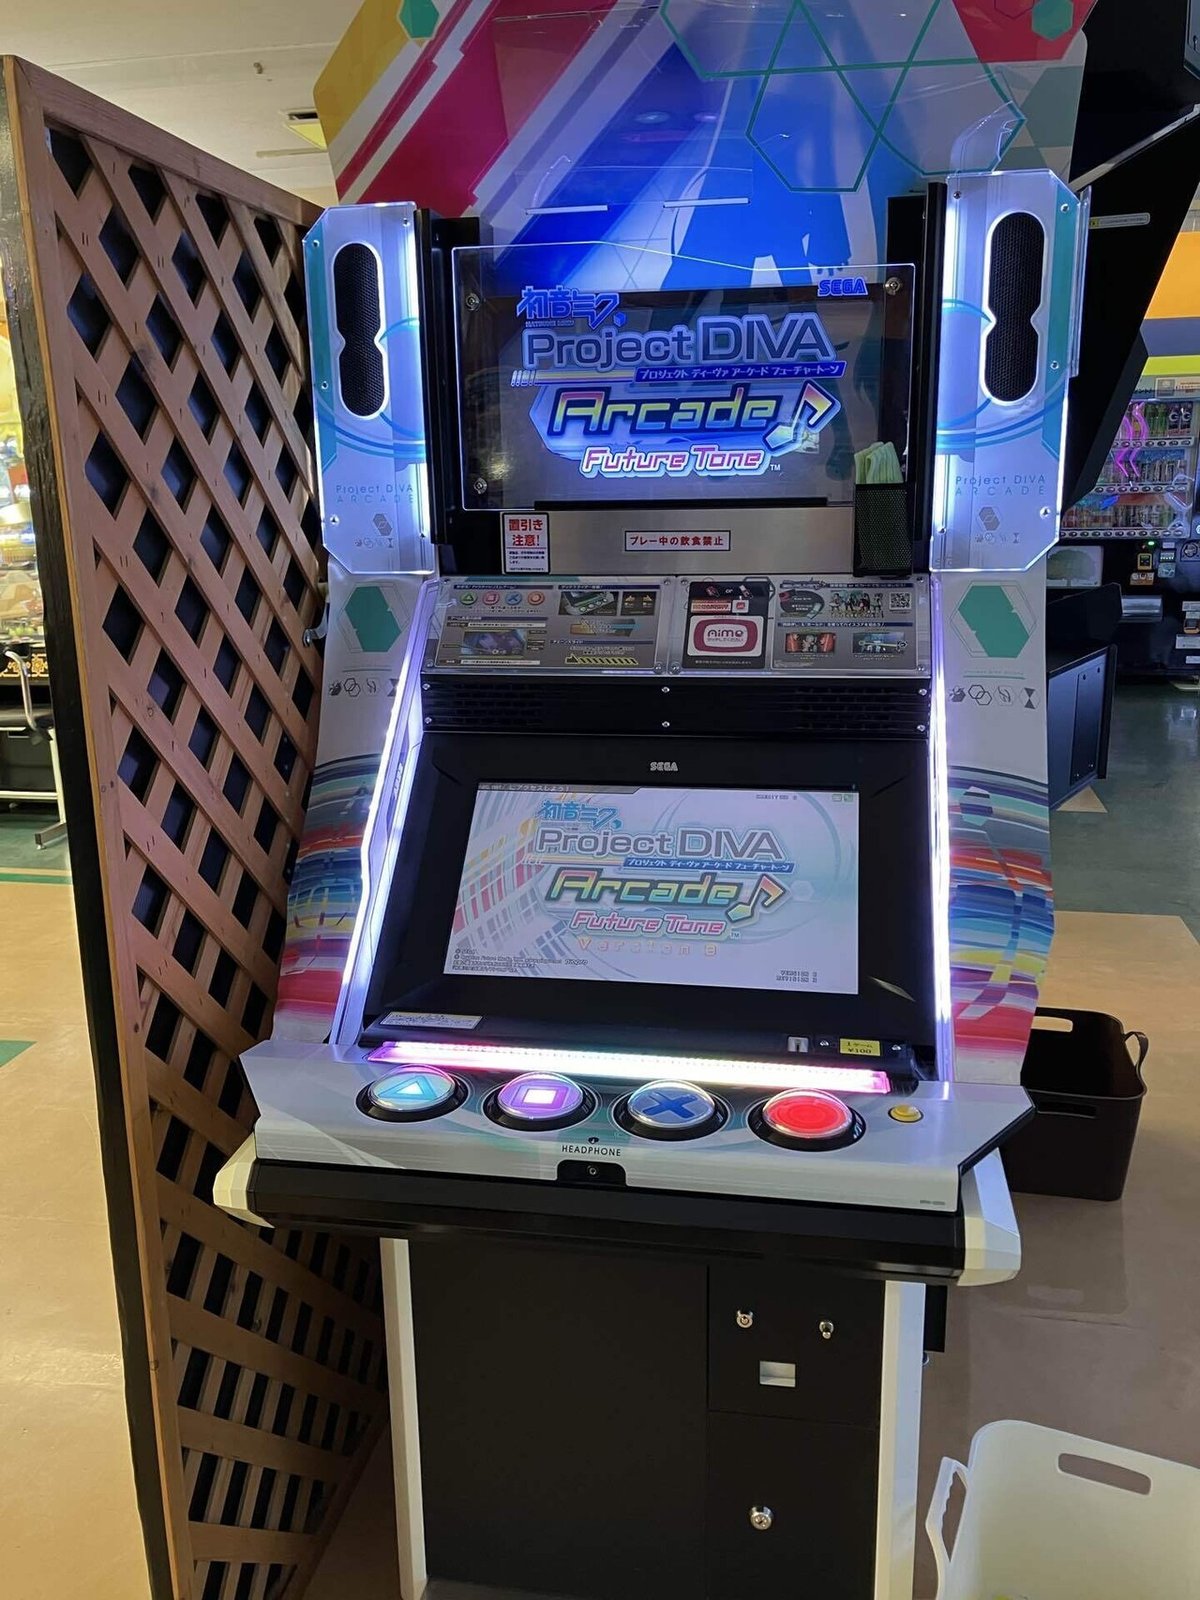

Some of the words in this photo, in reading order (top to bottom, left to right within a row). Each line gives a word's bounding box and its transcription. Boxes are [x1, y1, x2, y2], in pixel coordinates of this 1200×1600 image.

[817, 278, 869, 297] SEGA
[516, 285, 620, 330] 初音ミク
[528, 325, 692, 370] Project
[702, 317, 832, 361] DIVA
[551, 386, 778, 433] Arcade
[583, 449, 688, 472] Future
[690, 445, 764, 469] Tone
[336, 484, 380, 494] Project
[956, 476, 1006, 486] Project
[1014, 474, 1046, 484] DIVA
[955, 485, 1045, 497] ARCADE
[509, 518, 543, 531] 置引き
[512, 534, 540, 546] 注意!
[630, 534, 724, 546] プレー中の飲食禁止
[650, 761, 679, 771] SEGA
[538, 801, 617, 830] 初音ミク
[538, 829, 672, 857] Project
[682, 831, 783, 858] DIVA
[550, 870, 739, 903] Arcade
[572, 911, 660, 932] Future
[663, 914, 727, 934] Tone
[578, 936, 690, 955] Version
[561, 1145, 621, 1157] HEADPHONE
